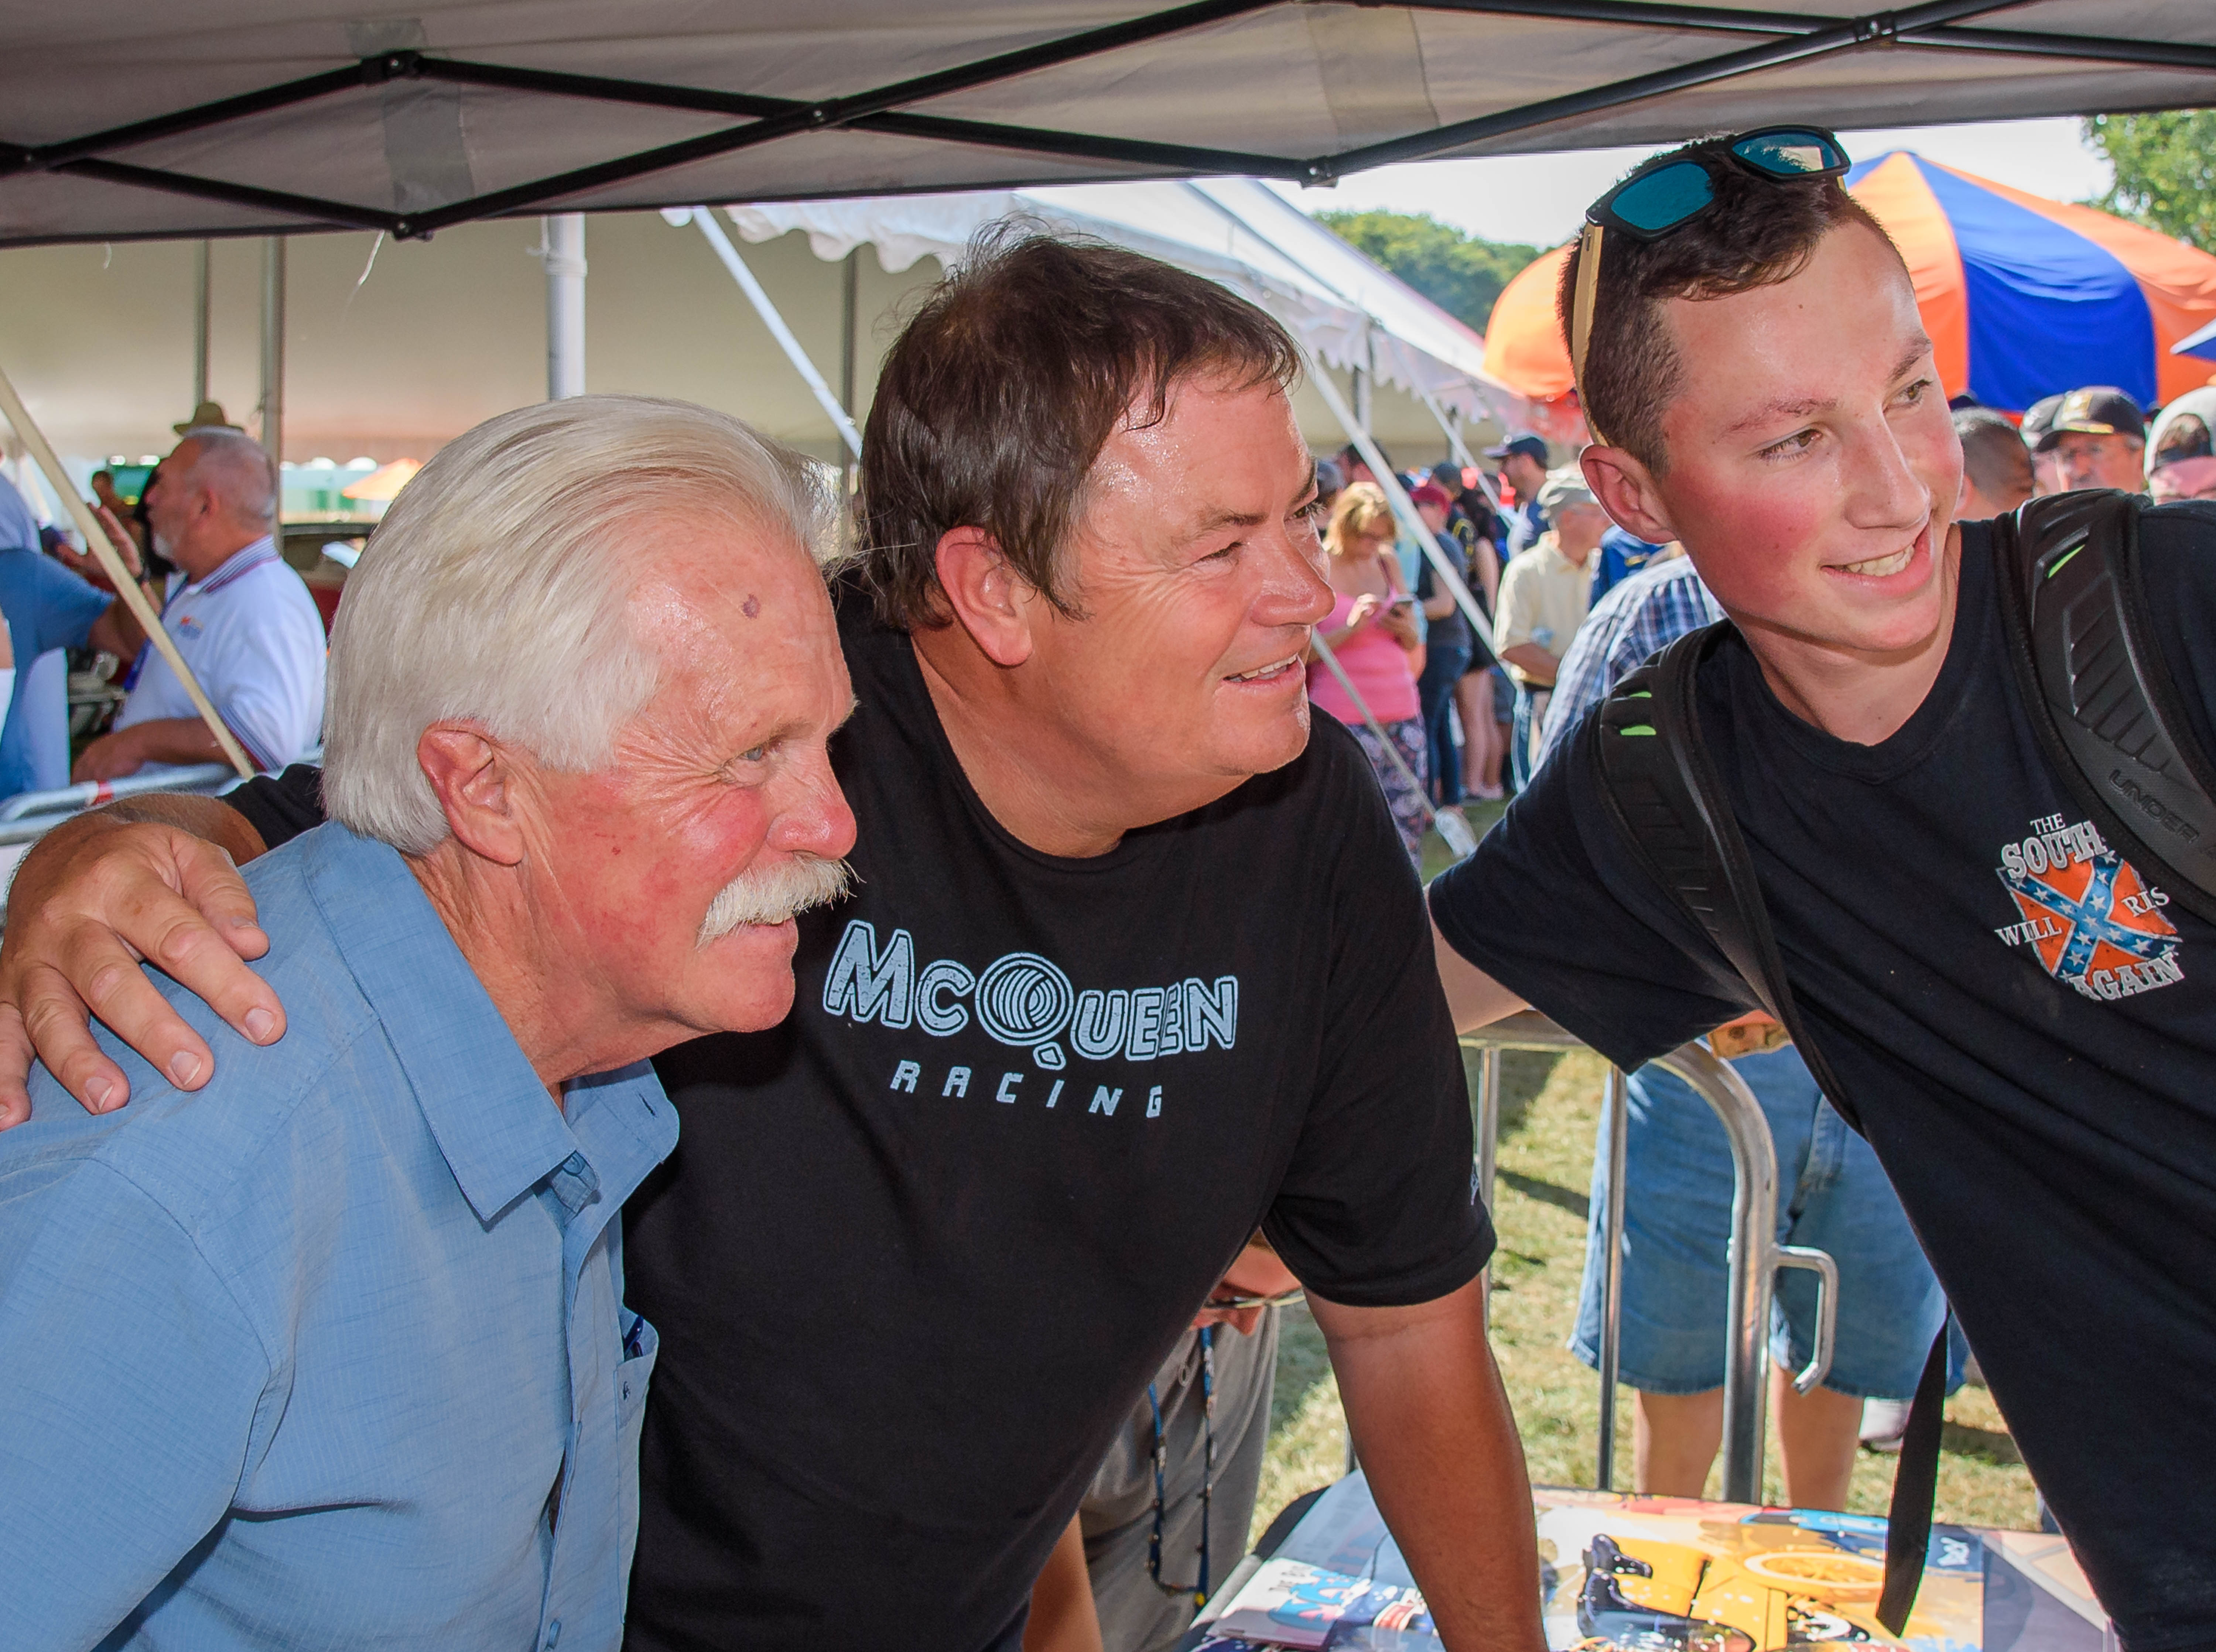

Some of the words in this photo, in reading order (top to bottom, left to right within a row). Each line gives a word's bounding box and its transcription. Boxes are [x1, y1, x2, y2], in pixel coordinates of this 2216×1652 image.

[2030, 813, 2066, 835] THE
[2109, 769, 2200, 844] UNDER
[2001, 820, 2108, 879] SOUTH
[1994, 916, 2063, 946] WILL
[2121, 887, 2170, 917] RIS
[2069, 952, 2185, 1001] AGAIN
[890, 1060, 1163, 1118] RACING
